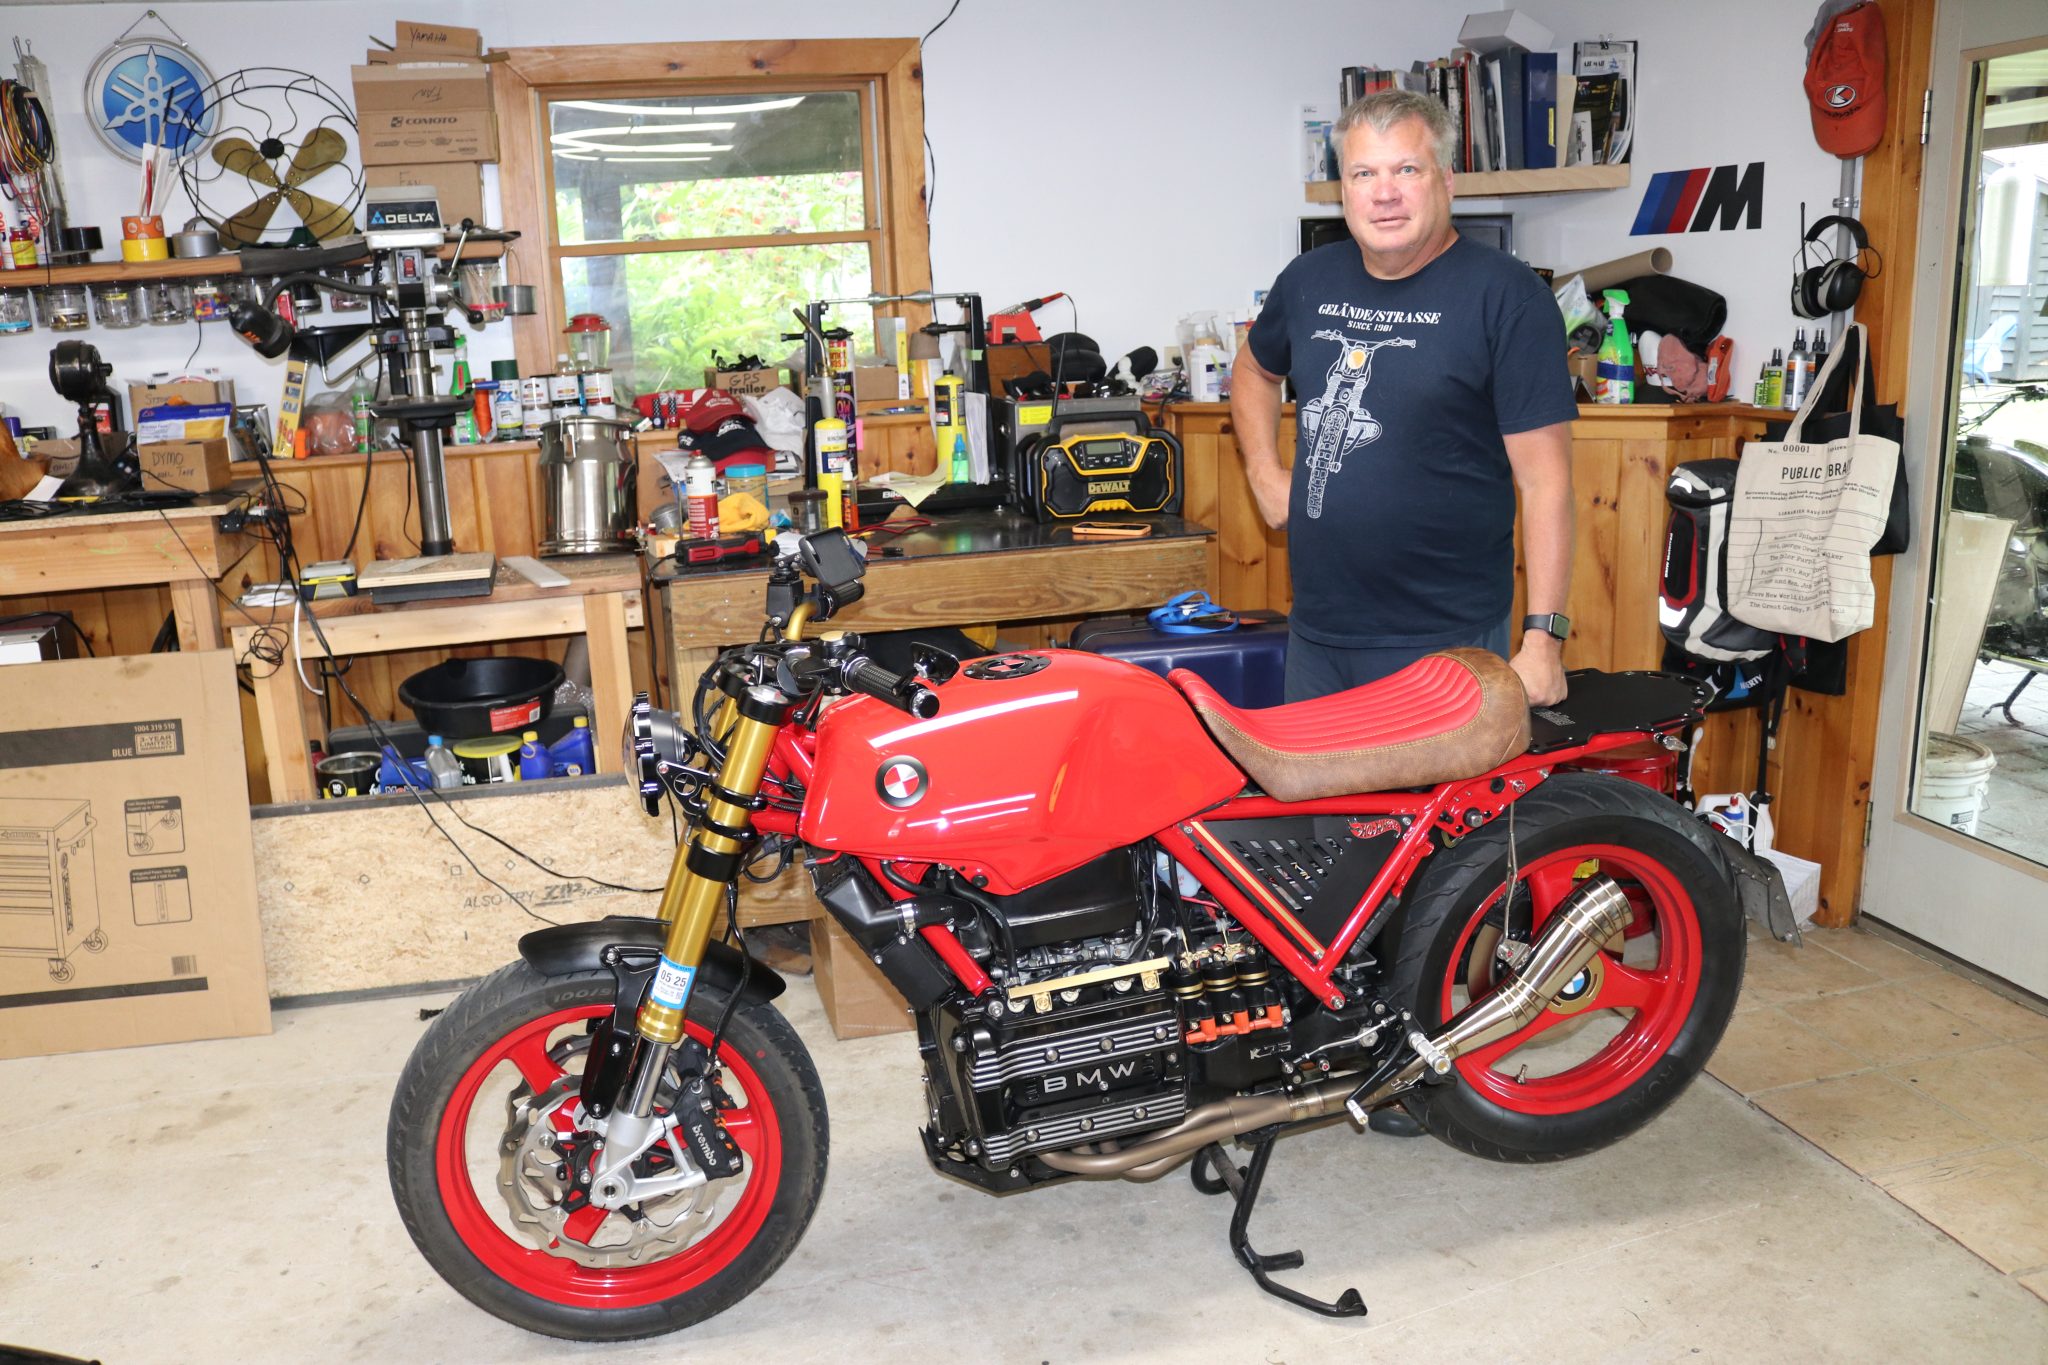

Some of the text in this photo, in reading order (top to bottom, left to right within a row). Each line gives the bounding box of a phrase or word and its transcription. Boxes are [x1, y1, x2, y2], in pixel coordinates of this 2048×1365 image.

[405, 117, 457, 126] COMOTO
[385, 213, 434, 224] DELTA
[1318, 302, 1441, 324] GELÄNDE/STRASSE
[1347, 320, 1393, 332] SINCE 1981
[729, 373, 760, 387] GPS
[1782, 444, 1810, 453] 00001
[152, 452, 184, 466] DYMO
[1781, 467, 1822, 479] PUBLIC
[112, 747, 133, 757] BLUE
[464, 893, 502, 909] ALSO
[507, 890, 535, 903] TRY
[660, 969, 687, 988] 05 25
[1043, 1061, 1136, 1093] BMW
[692, 1124, 717, 1166] brembo
